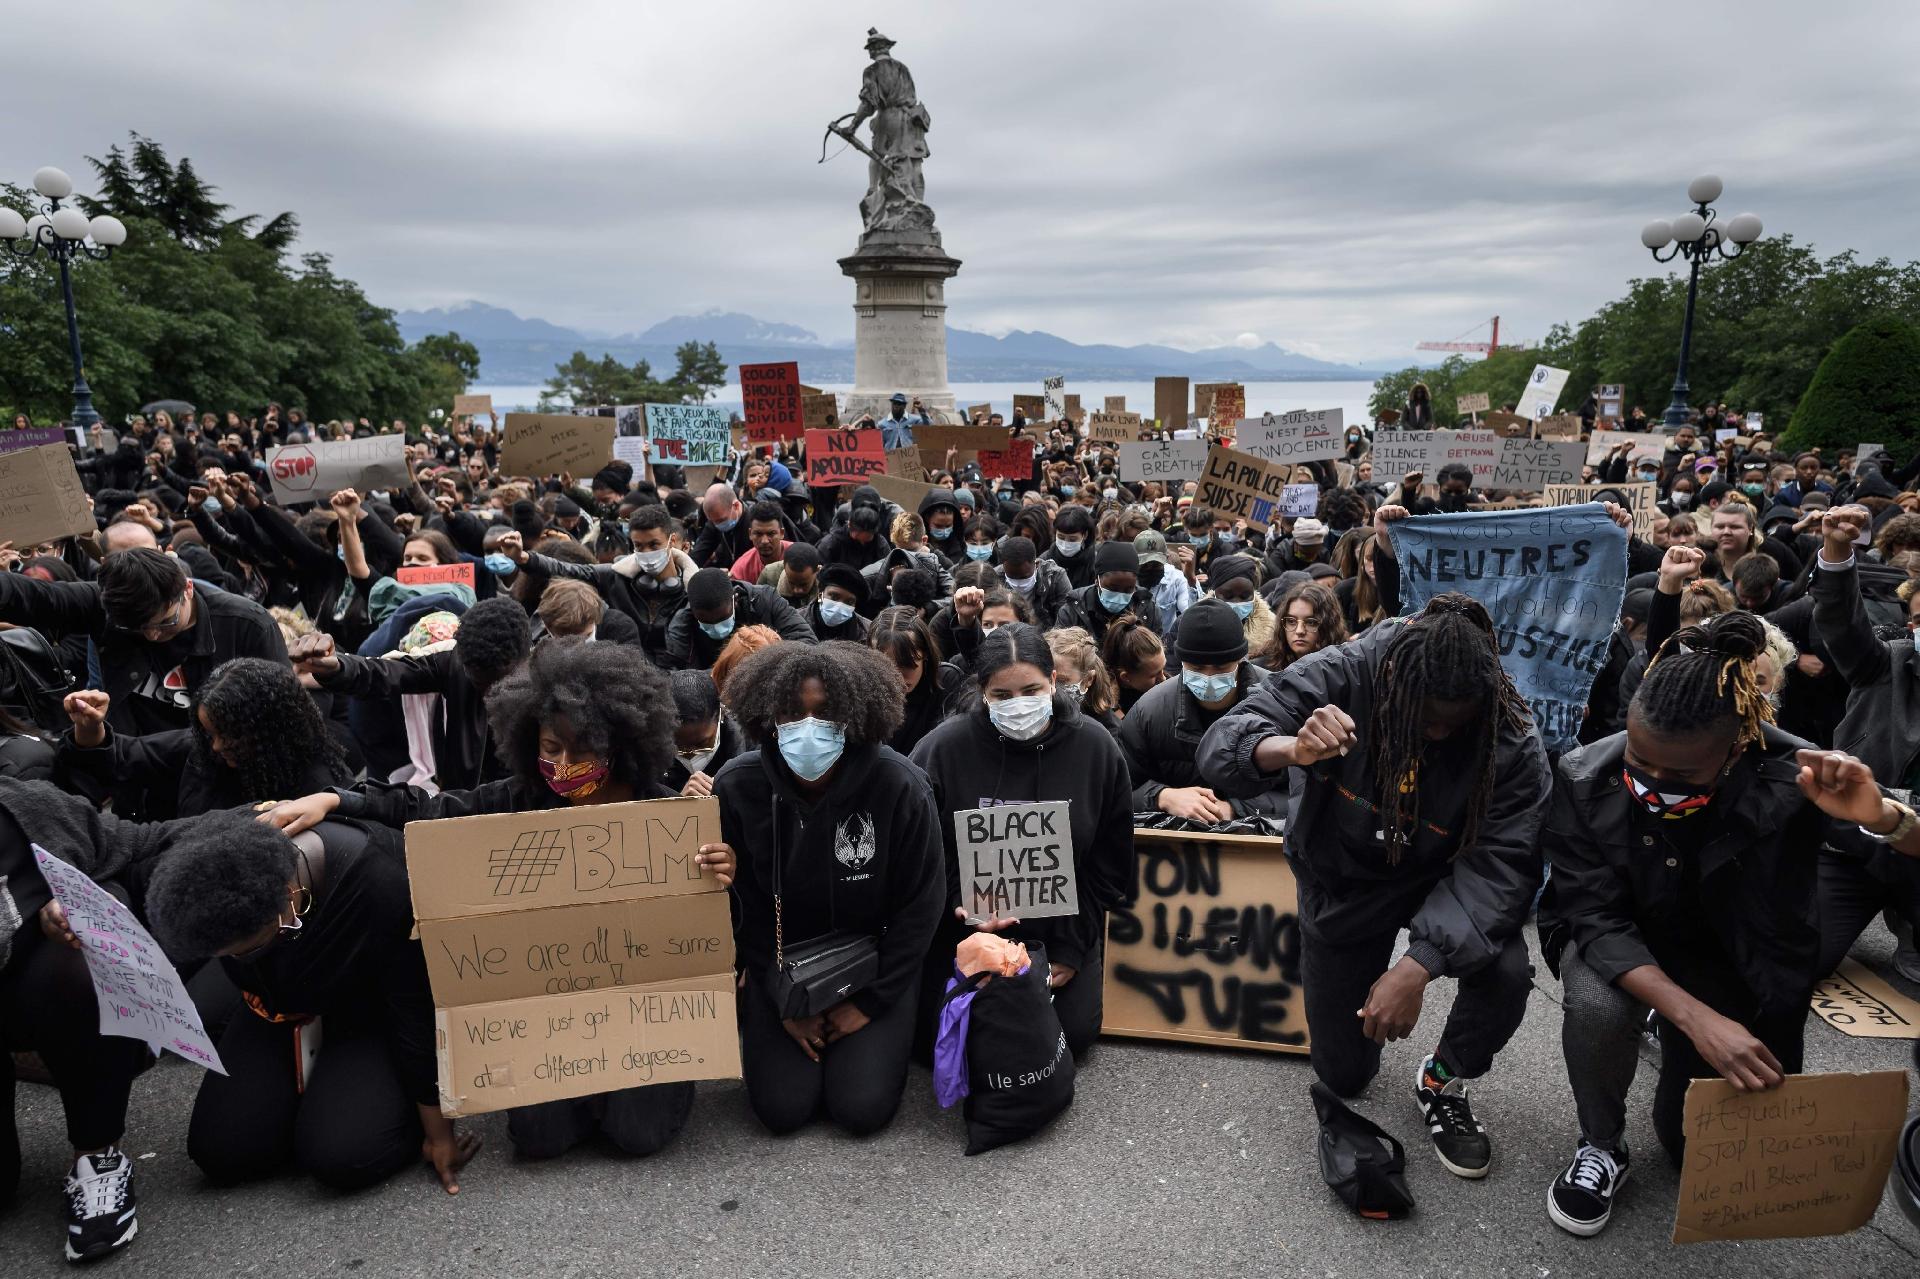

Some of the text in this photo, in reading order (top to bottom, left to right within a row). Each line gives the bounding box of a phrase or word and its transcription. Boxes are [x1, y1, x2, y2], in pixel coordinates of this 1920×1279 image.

[743, 368, 786, 379] COLOR
[745, 384, 795, 396] SHOULD
[651, 406, 720, 419] JE NE VEUX PAS
[745, 398, 796, 410] NEVER
[1261, 412, 1326, 426] LA SUISSE
[19, 431, 50, 441] Attack
[1266, 424, 1328, 440] N'EST PAS
[1377, 432, 1433, 443] SILENCE
[1455, 433, 1494, 442] ABUSE
[322, 440, 400, 462] KILLING
[828, 433, 858, 452] NO
[1504, 440, 1555, 450] BLACK
[1375, 448, 1494, 458] SILENCE BETRAYAL
[1500, 453, 1561, 466] LIVES
[274, 457, 315, 479] STOP
[1494, 466, 1573, 485] MATTER
[1200, 481, 1252, 516] SUISSE
[1450, 522, 1514, 541] vous
[1408, 539, 1593, 582] NEUTRES
[966, 810, 1057, 844] BLACK
[488, 815, 702, 897] #BLM
[973, 844, 1061, 878] LIVES
[973, 874, 1069, 915] MATTER
[441, 926, 721, 981] We are all the same
[1113, 963, 1307, 1045] TUE
[464, 991, 717, 1046] We've just got MELANIN
[473, 1064, 492, 1089] at
[533, 1047, 609, 1084] different
[1018, 1060, 1056, 1086] savoir
[1692, 1184, 1721, 1204] We
[1729, 1168, 1756, 1196] all
[1767, 1159, 1818, 1190] Bleed
